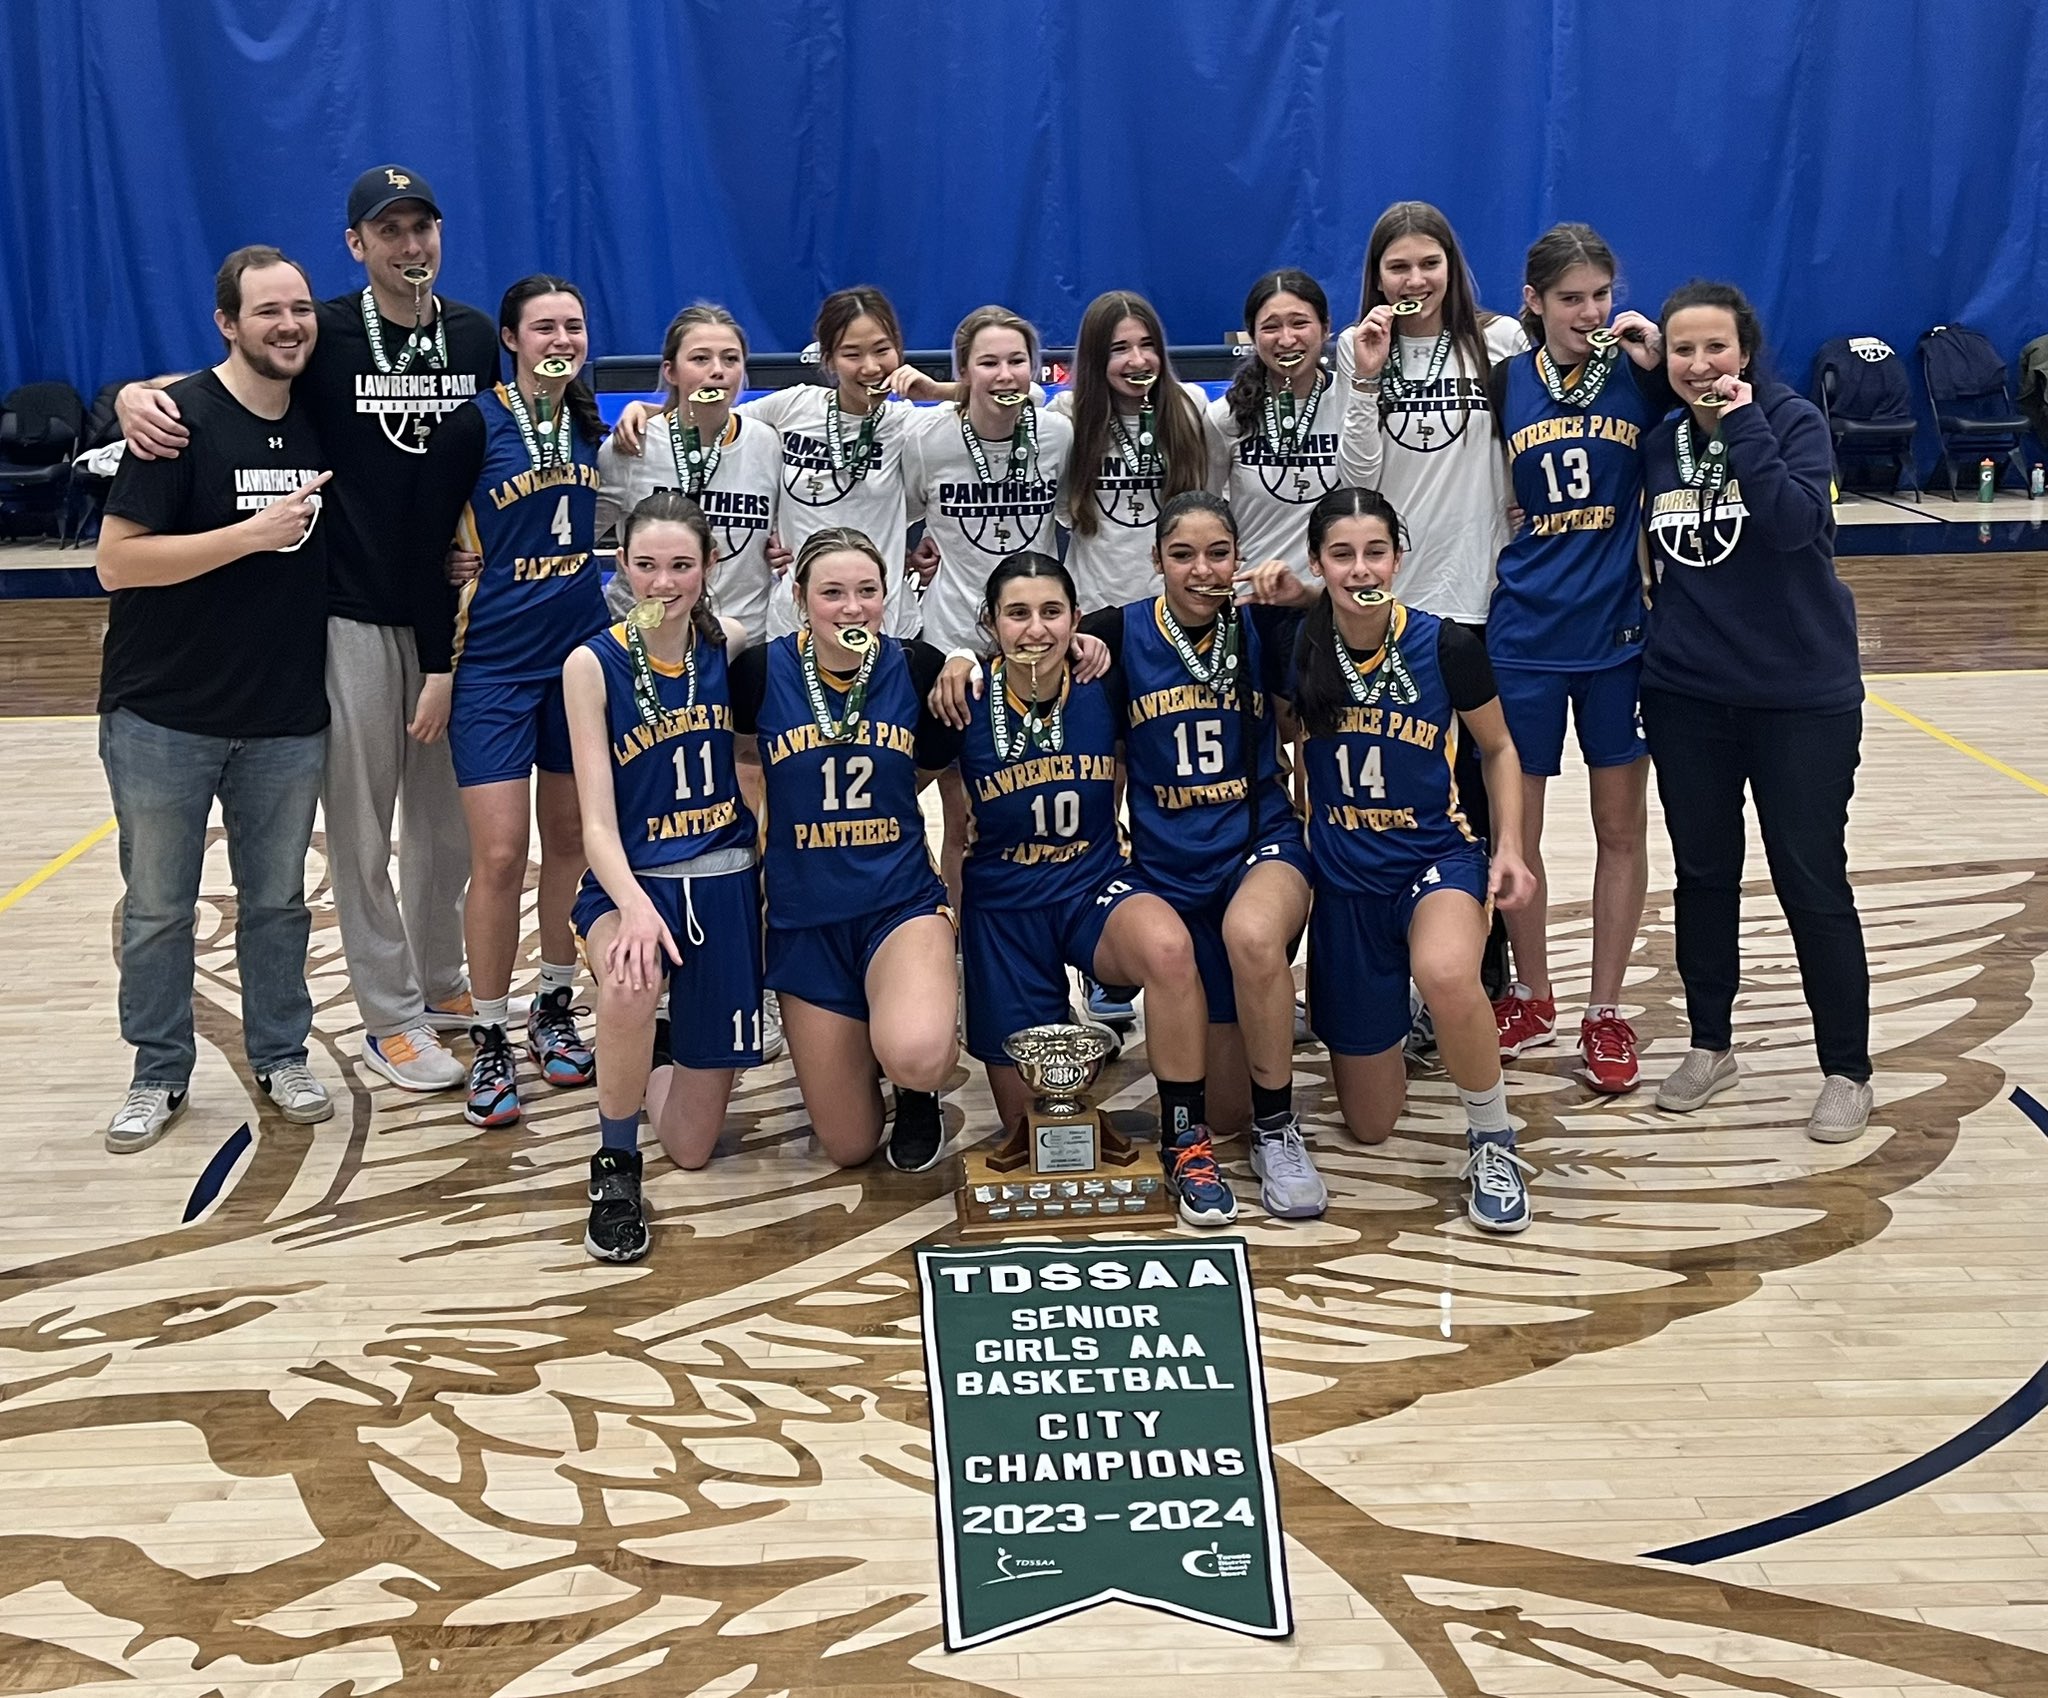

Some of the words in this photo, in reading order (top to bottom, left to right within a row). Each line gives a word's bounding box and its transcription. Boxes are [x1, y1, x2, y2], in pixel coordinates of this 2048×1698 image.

[355, 374, 438, 397] LAWRENCE
[441, 374, 477, 397] PARK
[1588, 415, 1641, 450] PARK
[1540, 447, 1591, 503] 13
[1981, 470, 1992, 481] G
[551, 496, 572, 546] 4
[1173, 719, 1225, 777] 15
[1387, 710, 1439, 751] PARK
[672, 740, 715, 801] 11
[820, 755, 874, 811] 12
[975, 755, 1075, 803] LAWRENCE
[1335, 744, 1386, 799] 14
[1031, 790, 1080, 838] 10
[794, 816, 901, 850] PANTHERS
[732, 1009, 762, 1051] 11
[940, 1259, 1229, 1295] TDSSAA
[1011, 1304, 1160, 1332] SENIOR
[975, 1336, 1099, 1364] GIRLS
[1129, 1333, 1206, 1360] AAA
[956, 1365, 1235, 1397] BASKETBALL
[1039, 1410, 1161, 1441] CITY
[964, 1448, 1246, 1484] CHAMPIONS
[1015, 1559, 1056, 1567] TDSSAA
